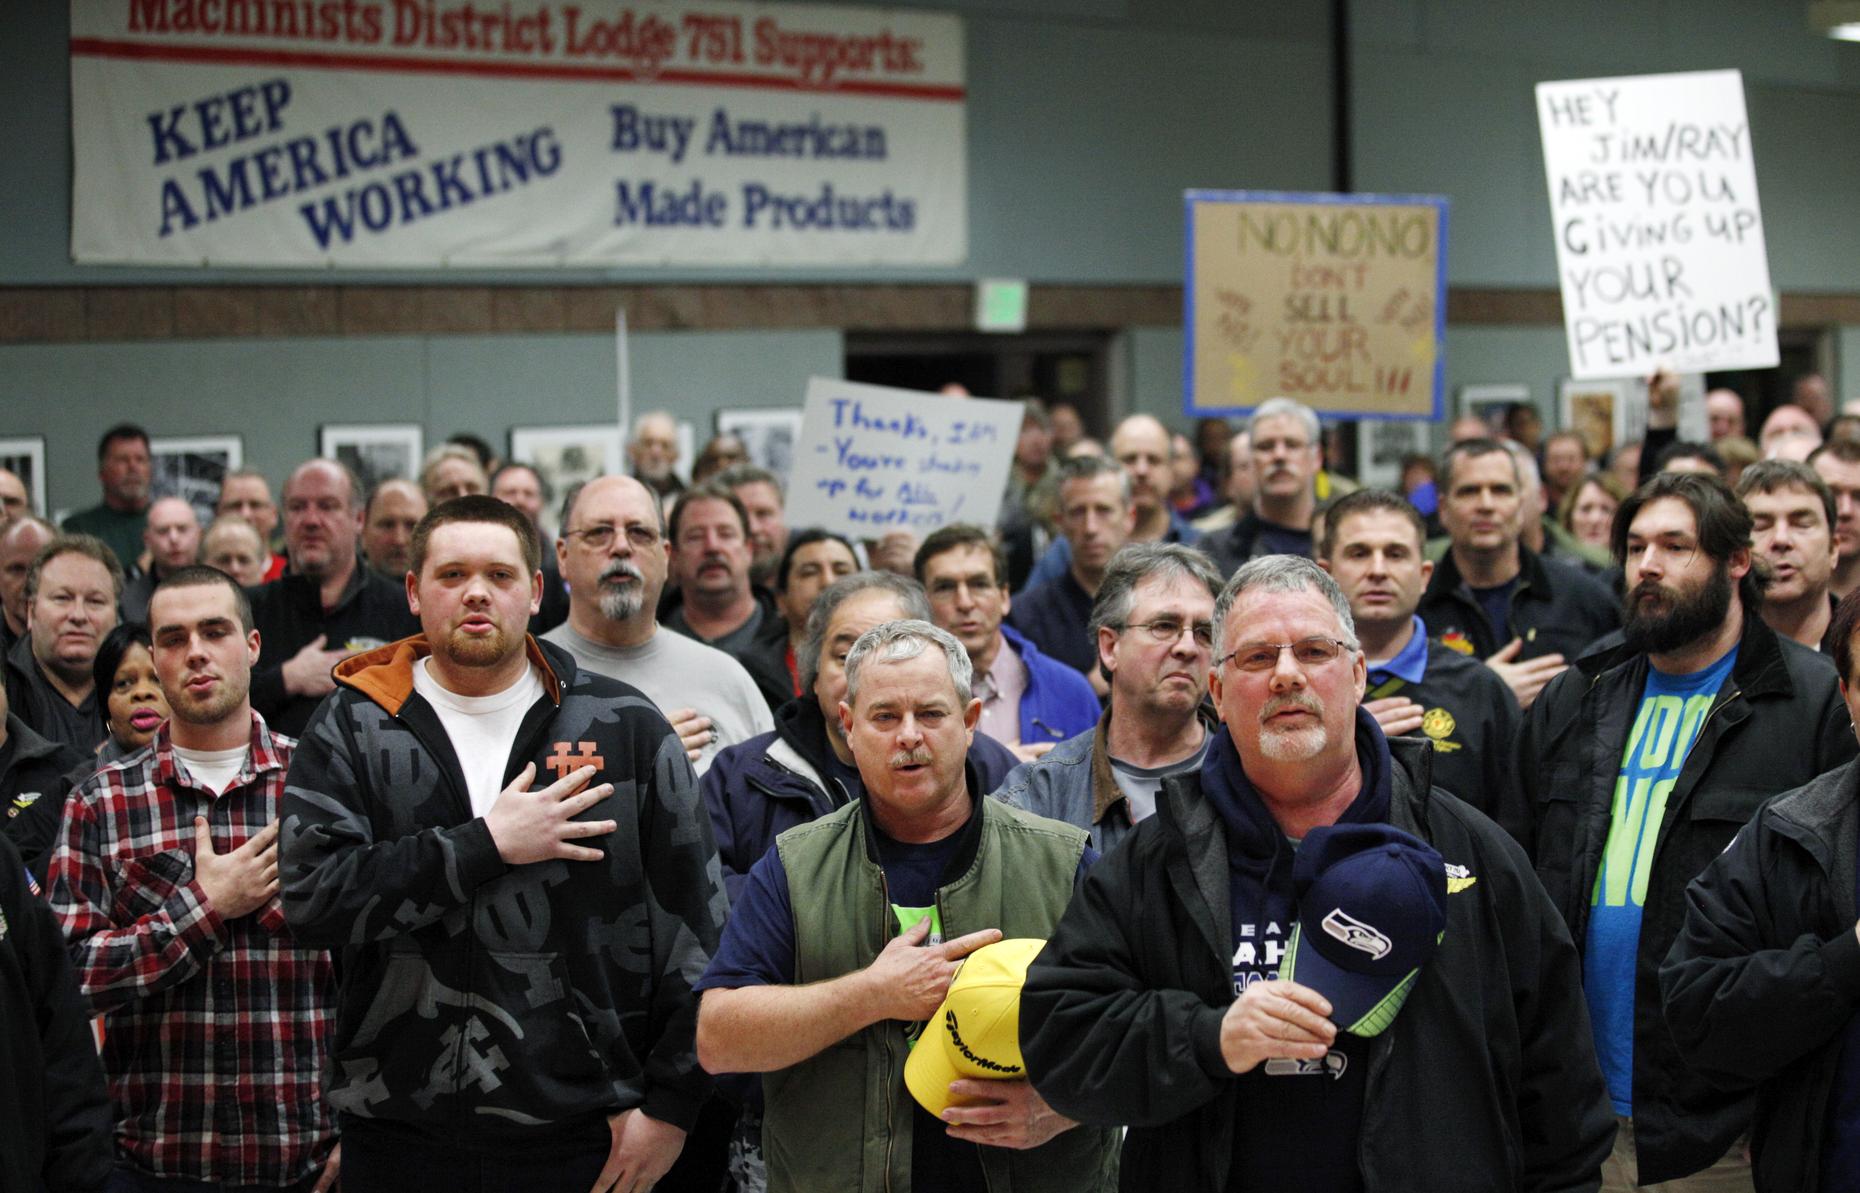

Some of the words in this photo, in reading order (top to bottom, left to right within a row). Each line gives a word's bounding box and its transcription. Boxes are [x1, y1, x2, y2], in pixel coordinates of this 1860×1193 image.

[127, 0, 384, 43] Machinists
[392, 0, 551, 53] District
[564, 7, 675, 81] Lodge
[684, 13, 745, 63] 751
[754, 18, 924, 87] Supports:
[148, 79, 292, 165] KEEP
[1548, 89, 1619, 126] HEY
[611, 106, 695, 163] Buy
[706, 109, 887, 159] American
[158, 110, 418, 238] AMERICA
[299, 127, 561, 250] WORKING
[1560, 170, 1624, 206] ARE
[1636, 171, 1736, 207] YOU
[614, 181, 726, 228] Made
[741, 184, 915, 231] Products
[1704, 209, 1756, 243] UP
[1283, 293, 1357, 323] SELL
[1568, 255, 1693, 309] YOUR
[1275, 325, 1373, 363] YOUR
